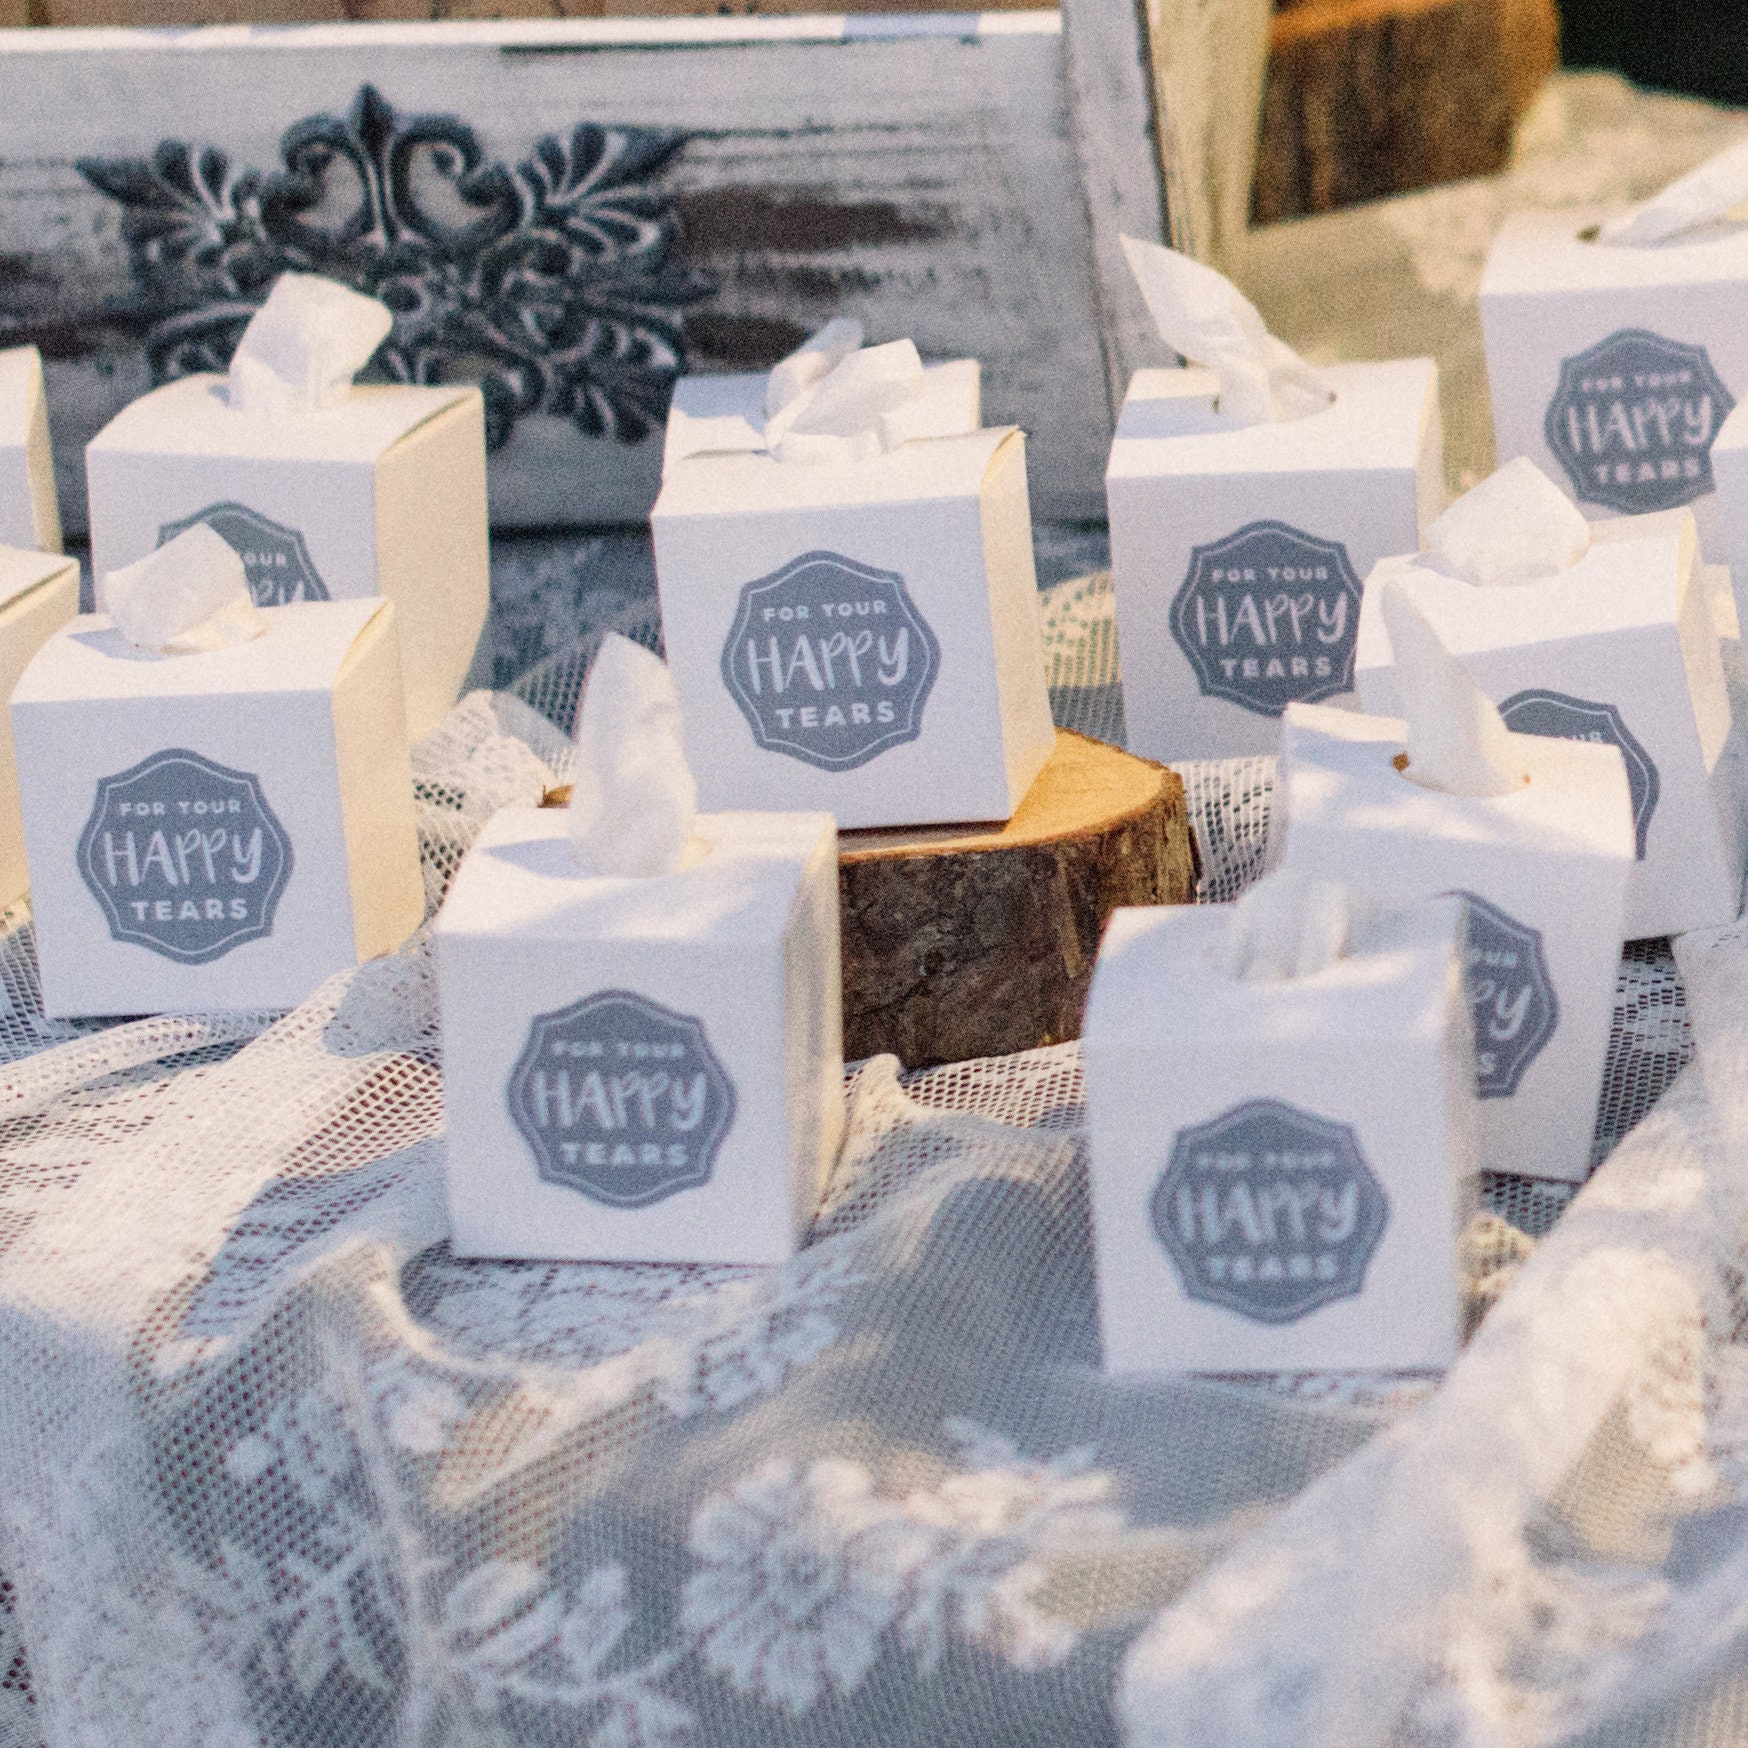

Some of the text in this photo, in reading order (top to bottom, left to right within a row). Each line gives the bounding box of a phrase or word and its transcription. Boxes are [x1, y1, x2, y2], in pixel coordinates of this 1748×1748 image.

[1596, 458, 1699, 483] TEARS
[1211, 567, 1328, 583] FOR YOUR
[763, 600, 888, 622] FOR YOUR
[1196, 591, 1347, 646] HAPPY
[747, 627, 909, 696] HAPPY
[1219, 656, 1331, 678] TEARS
[775, 701, 897, 729] TEARS
[119, 799, 242, 817] FOR YOUR
[103, 827, 264, 887] HAPPY
[130, 899, 250, 921] TEARS
[533, 1069, 707, 1130] HAPPY
[559, 1142, 688, 1166] TEARS
